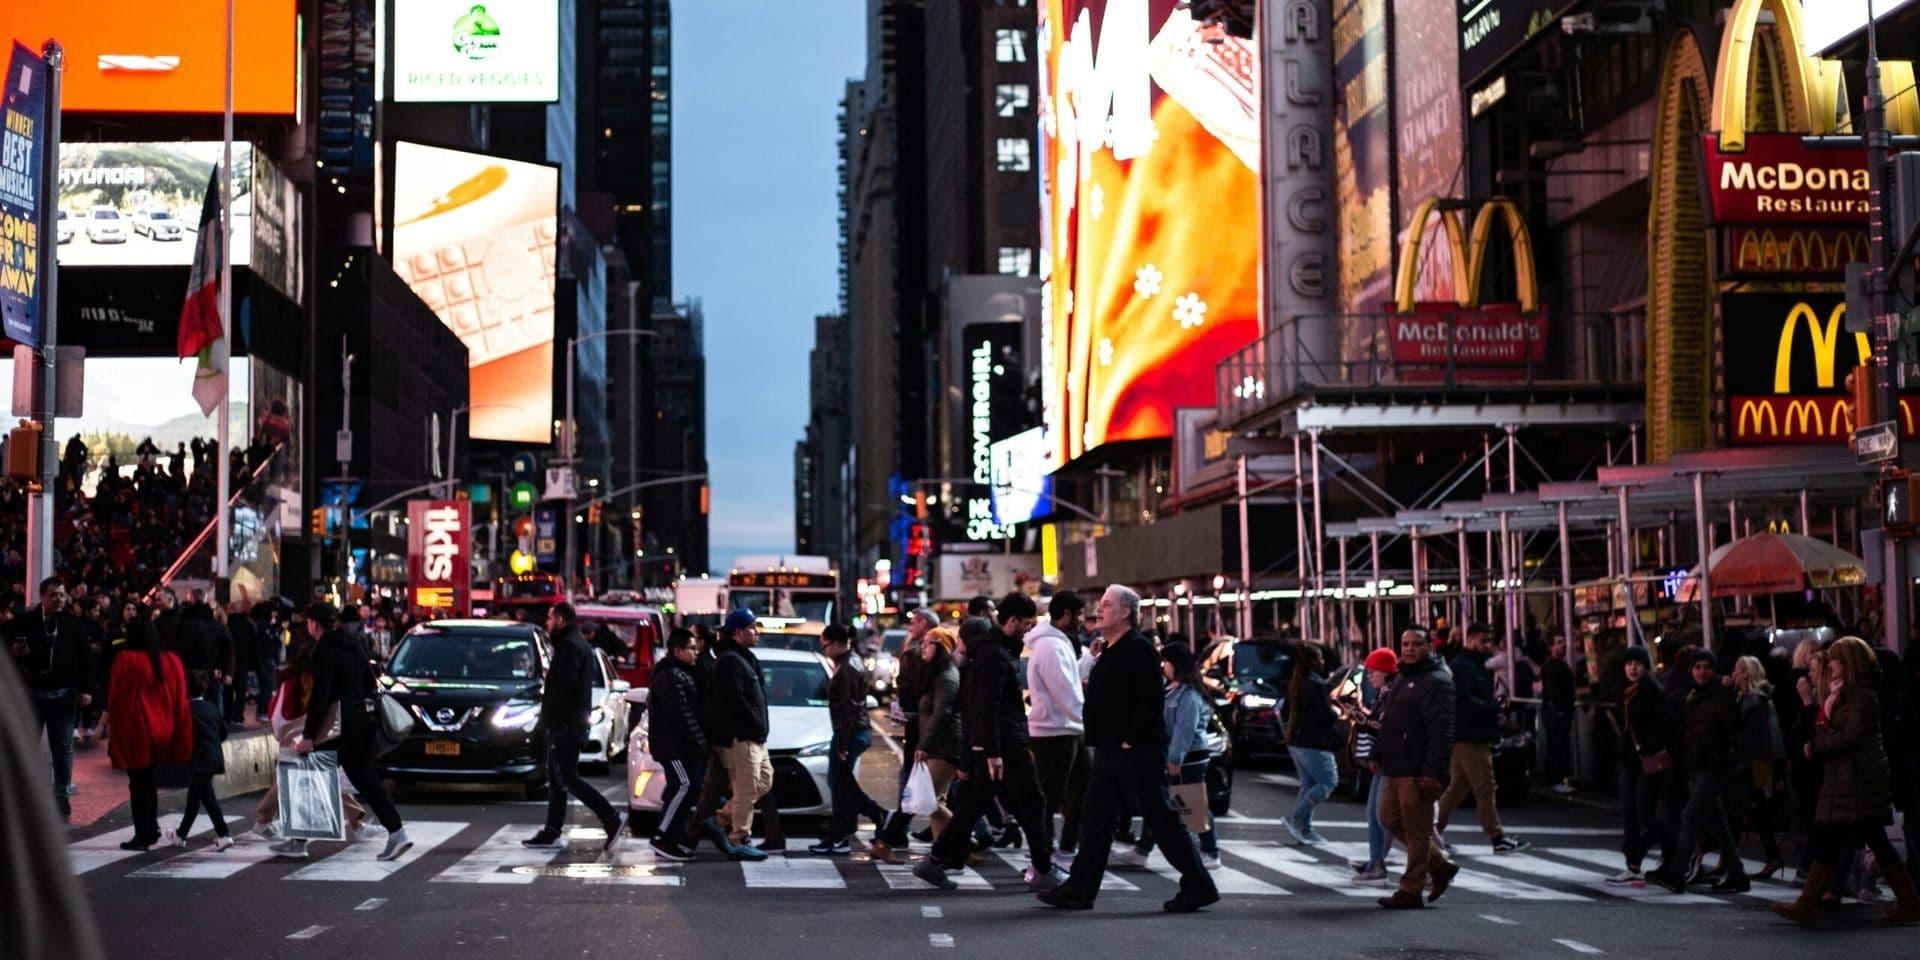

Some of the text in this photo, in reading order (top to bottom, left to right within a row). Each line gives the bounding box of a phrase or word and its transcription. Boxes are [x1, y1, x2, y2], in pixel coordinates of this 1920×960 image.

[408, 72, 544, 86] RICED VEGGIES
[2, 129, 33, 176] BEST
[0, 166, 34, 202] MUSICAL
[58, 167, 145, 185] HYUNDAI
[0, 263, 36, 298] AWAY
[1397, 321, 1541, 341] McDonald's
[972, 340, 992, 484] COVERGIRL
[1859, 430, 1890, 452] ONE WAY
[425, 506, 460, 581] tkts
